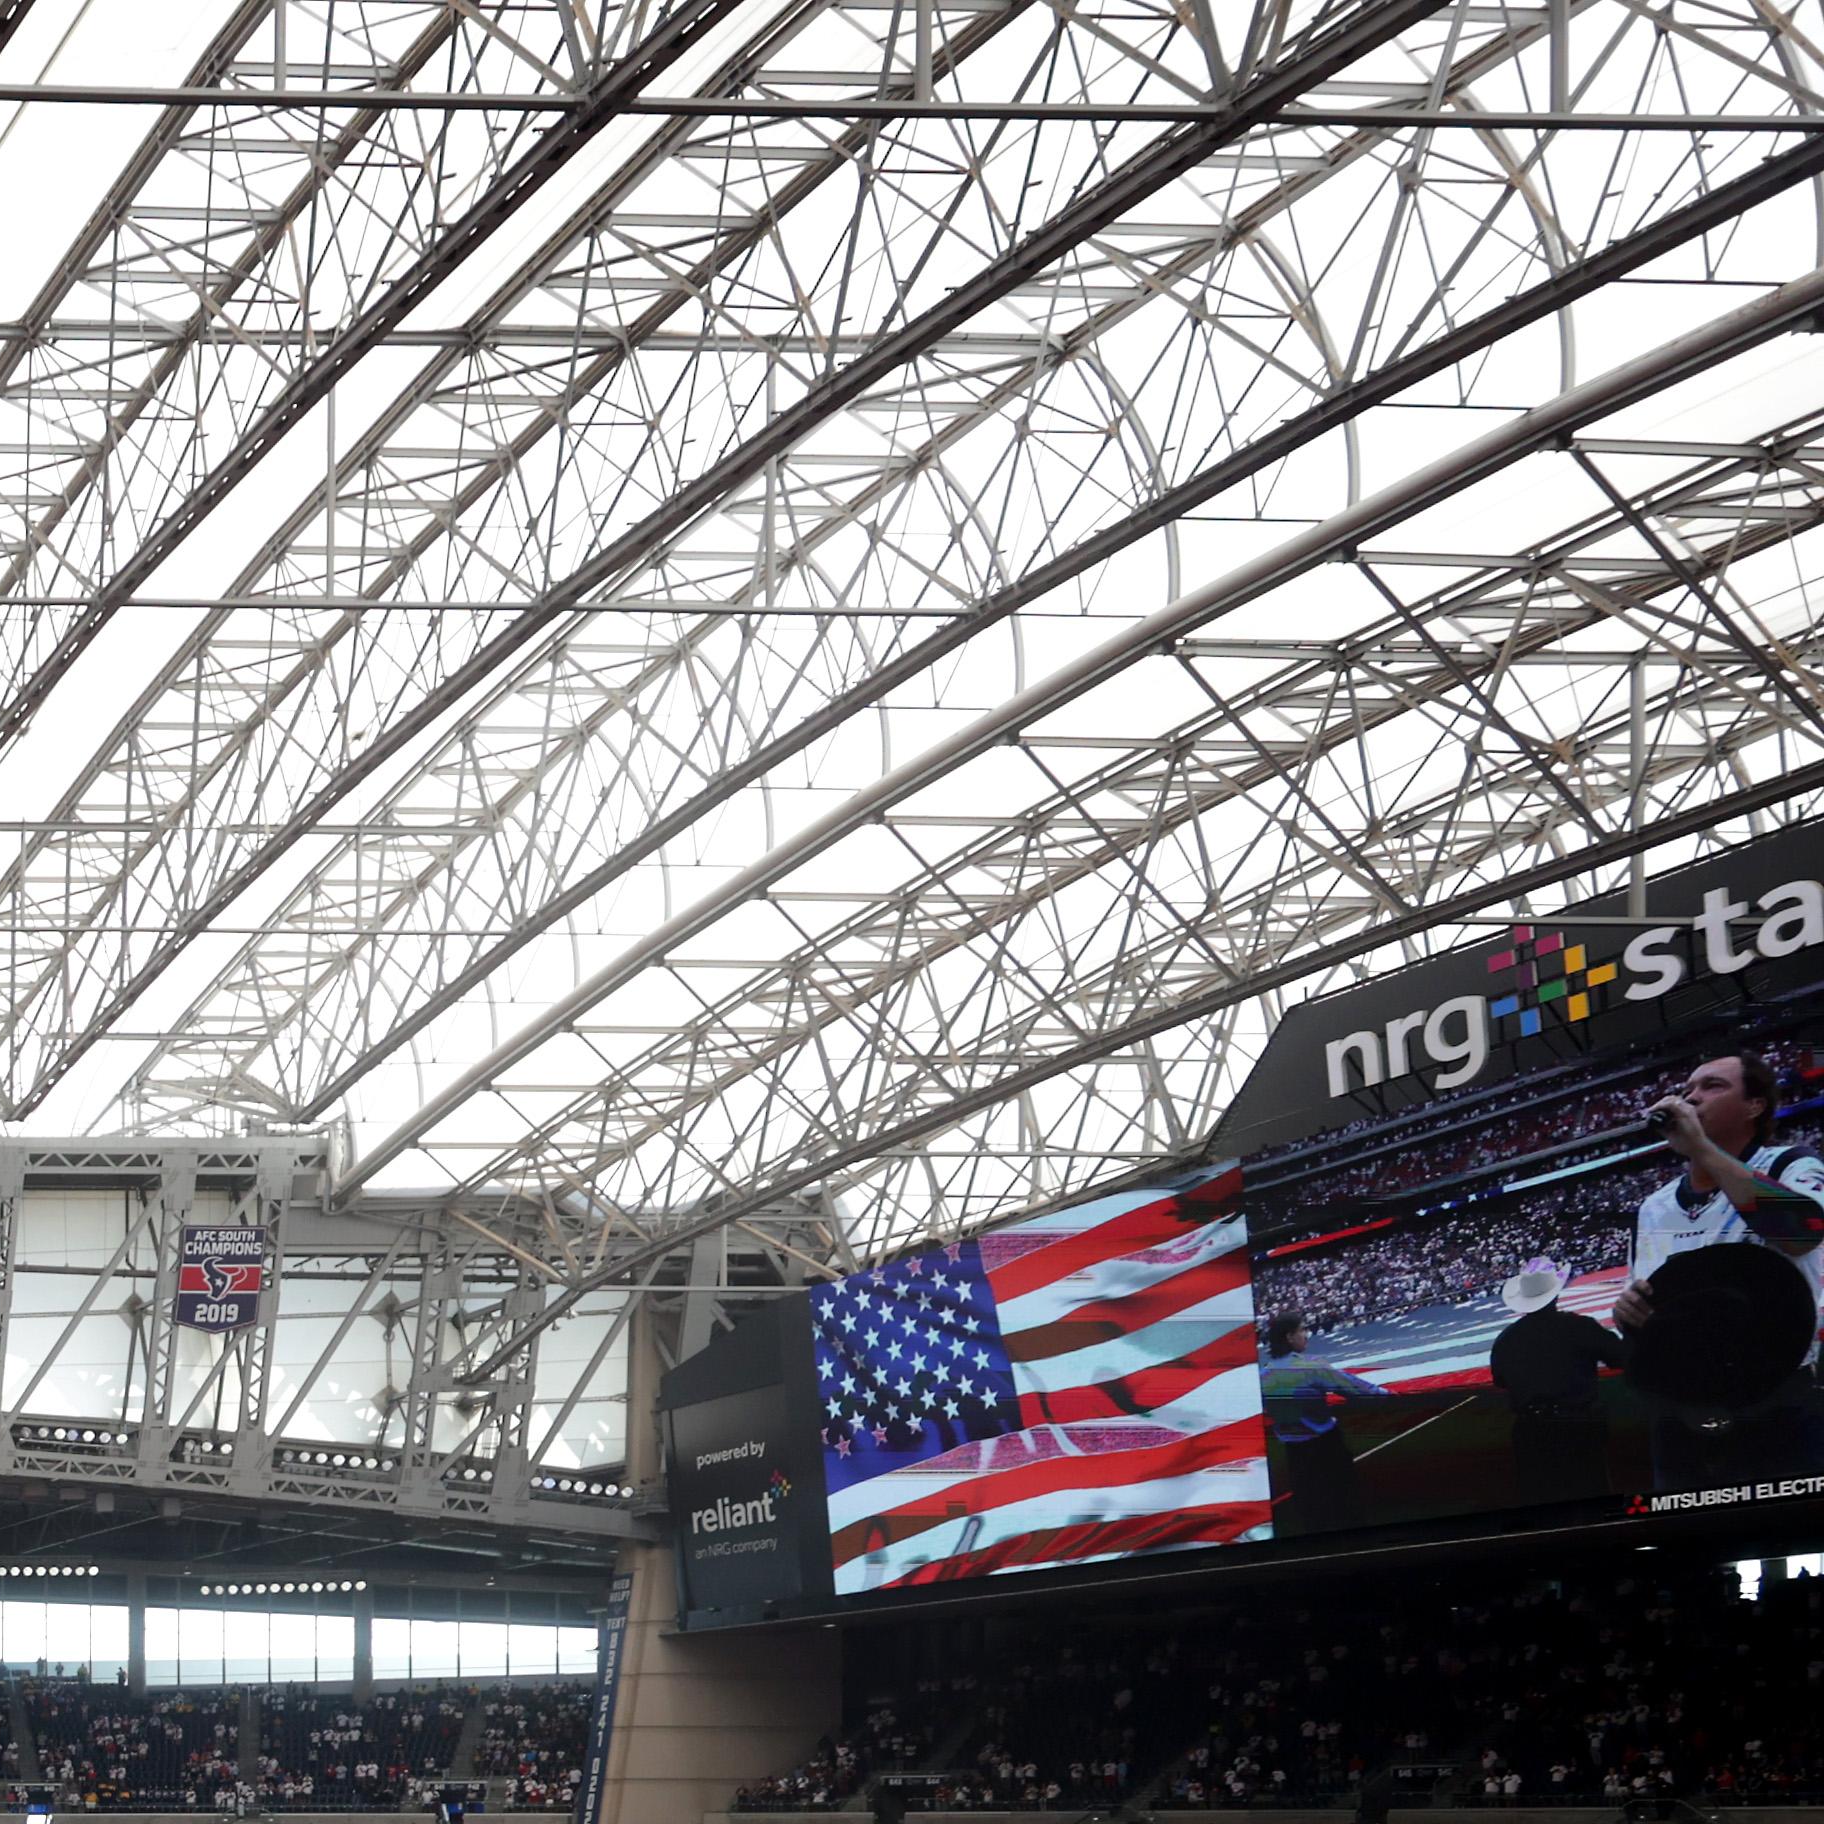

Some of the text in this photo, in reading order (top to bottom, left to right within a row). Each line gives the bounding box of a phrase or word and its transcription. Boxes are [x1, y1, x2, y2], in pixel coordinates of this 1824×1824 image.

[1325, 993, 1491, 1099] nrg
[195, 1231, 255, 1241] AFC SOUTH
[185, 1242, 262, 1255] CHAMPIONS
[195, 1304, 239, 1323] 2019
[696, 1441, 765, 1470] powered by
[1651, 1486, 1751, 1512] MITSUBISHI
[691, 1491, 776, 1534] reliant
[696, 1537, 778, 1559] an NRG company
